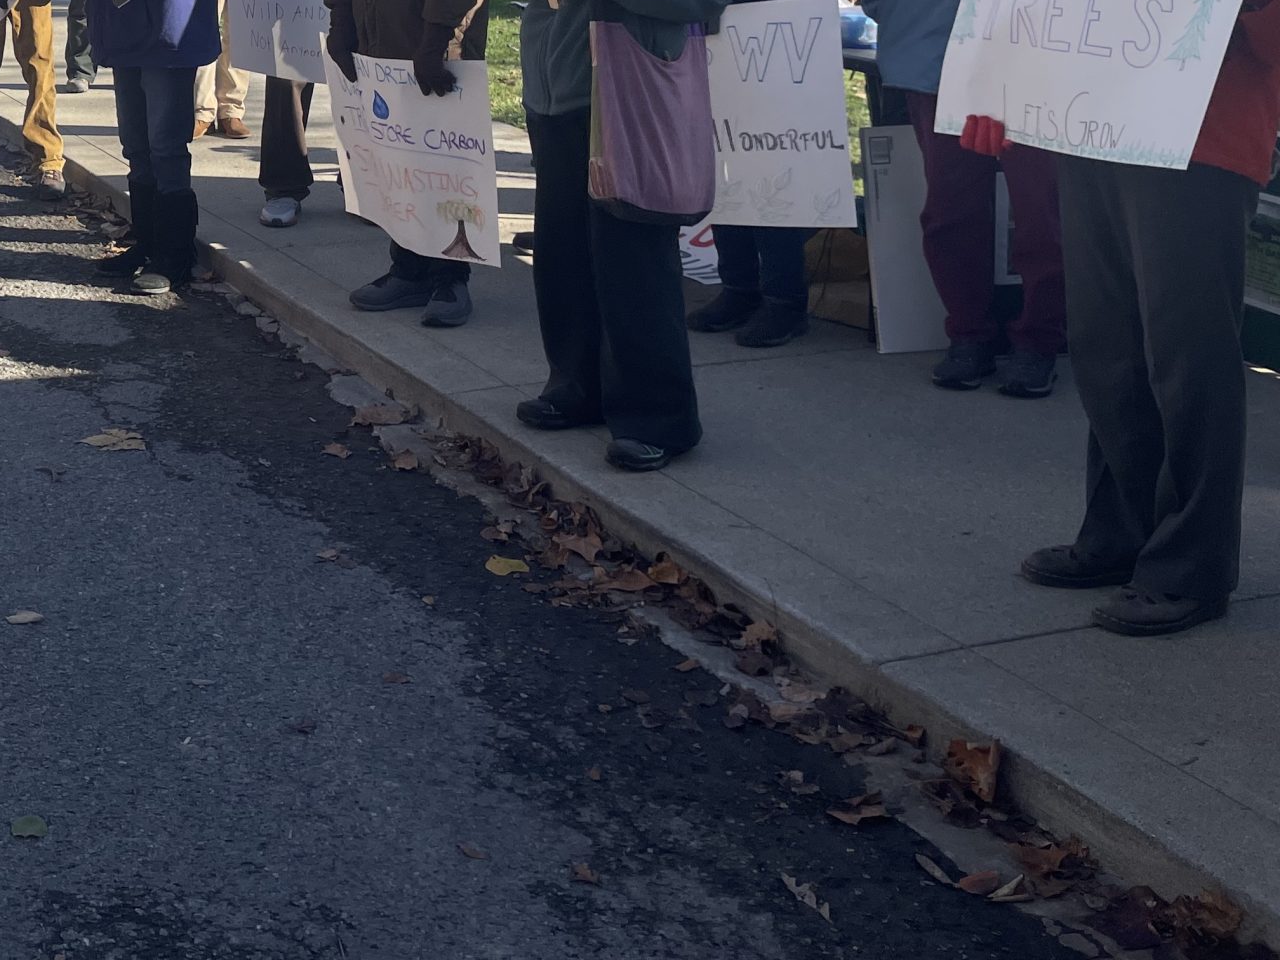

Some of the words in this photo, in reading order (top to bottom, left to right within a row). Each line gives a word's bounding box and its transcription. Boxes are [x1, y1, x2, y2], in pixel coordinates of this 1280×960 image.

[726, 17, 823, 84] WV
[423, 128, 486, 156] CARBON
[1064, 91, 1126, 149] GROW
